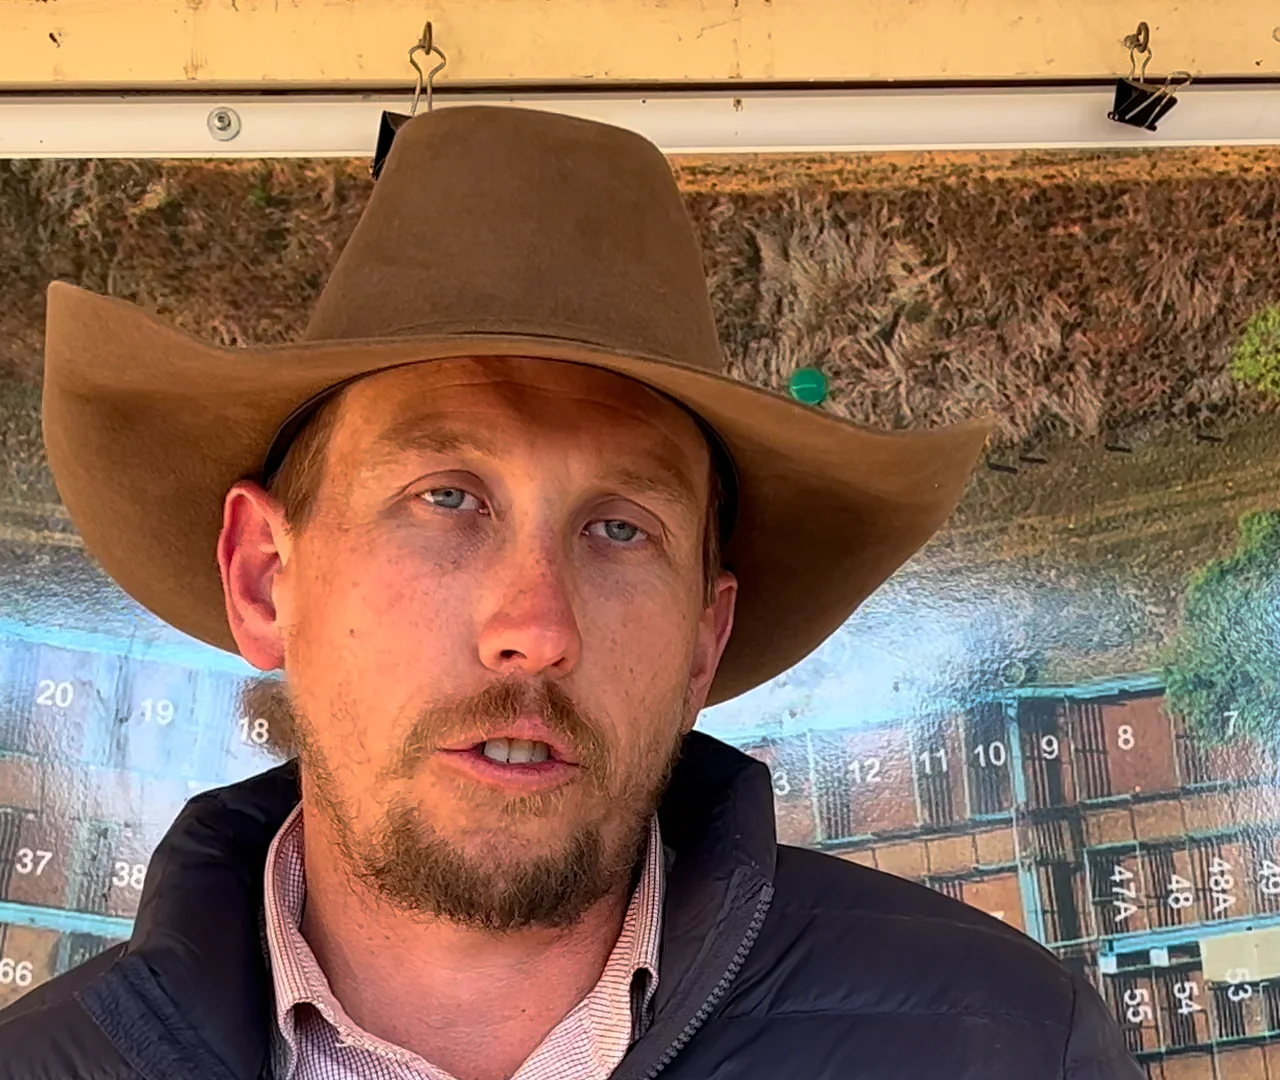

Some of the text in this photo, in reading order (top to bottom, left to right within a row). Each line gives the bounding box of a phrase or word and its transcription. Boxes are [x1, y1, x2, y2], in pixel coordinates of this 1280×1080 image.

[36, 680, 74, 708] 20
[140, 698, 174, 725] 19
[1222, 710, 1238, 737] 7
[239, 716, 269, 745] 18
[1117, 725, 1135, 751] 8
[974, 741, 1006, 768] 10
[1041, 734, 1060, 760] 9
[848, 757, 881, 784] 12
[919, 748, 948, 775] 11
[773, 770, 791, 796] 3
[15, 848, 53, 877] 37
[112, 863, 145, 889] 38
[1109, 864, 1139, 922] 47A
[1166, 874, 1192, 910] 48
[1208, 857, 1236, 913] 48A
[1172, 981, 1202, 1015] 54
[1224, 968, 1252, 1002] 53
[1122, 989, 1153, 1024] 55
